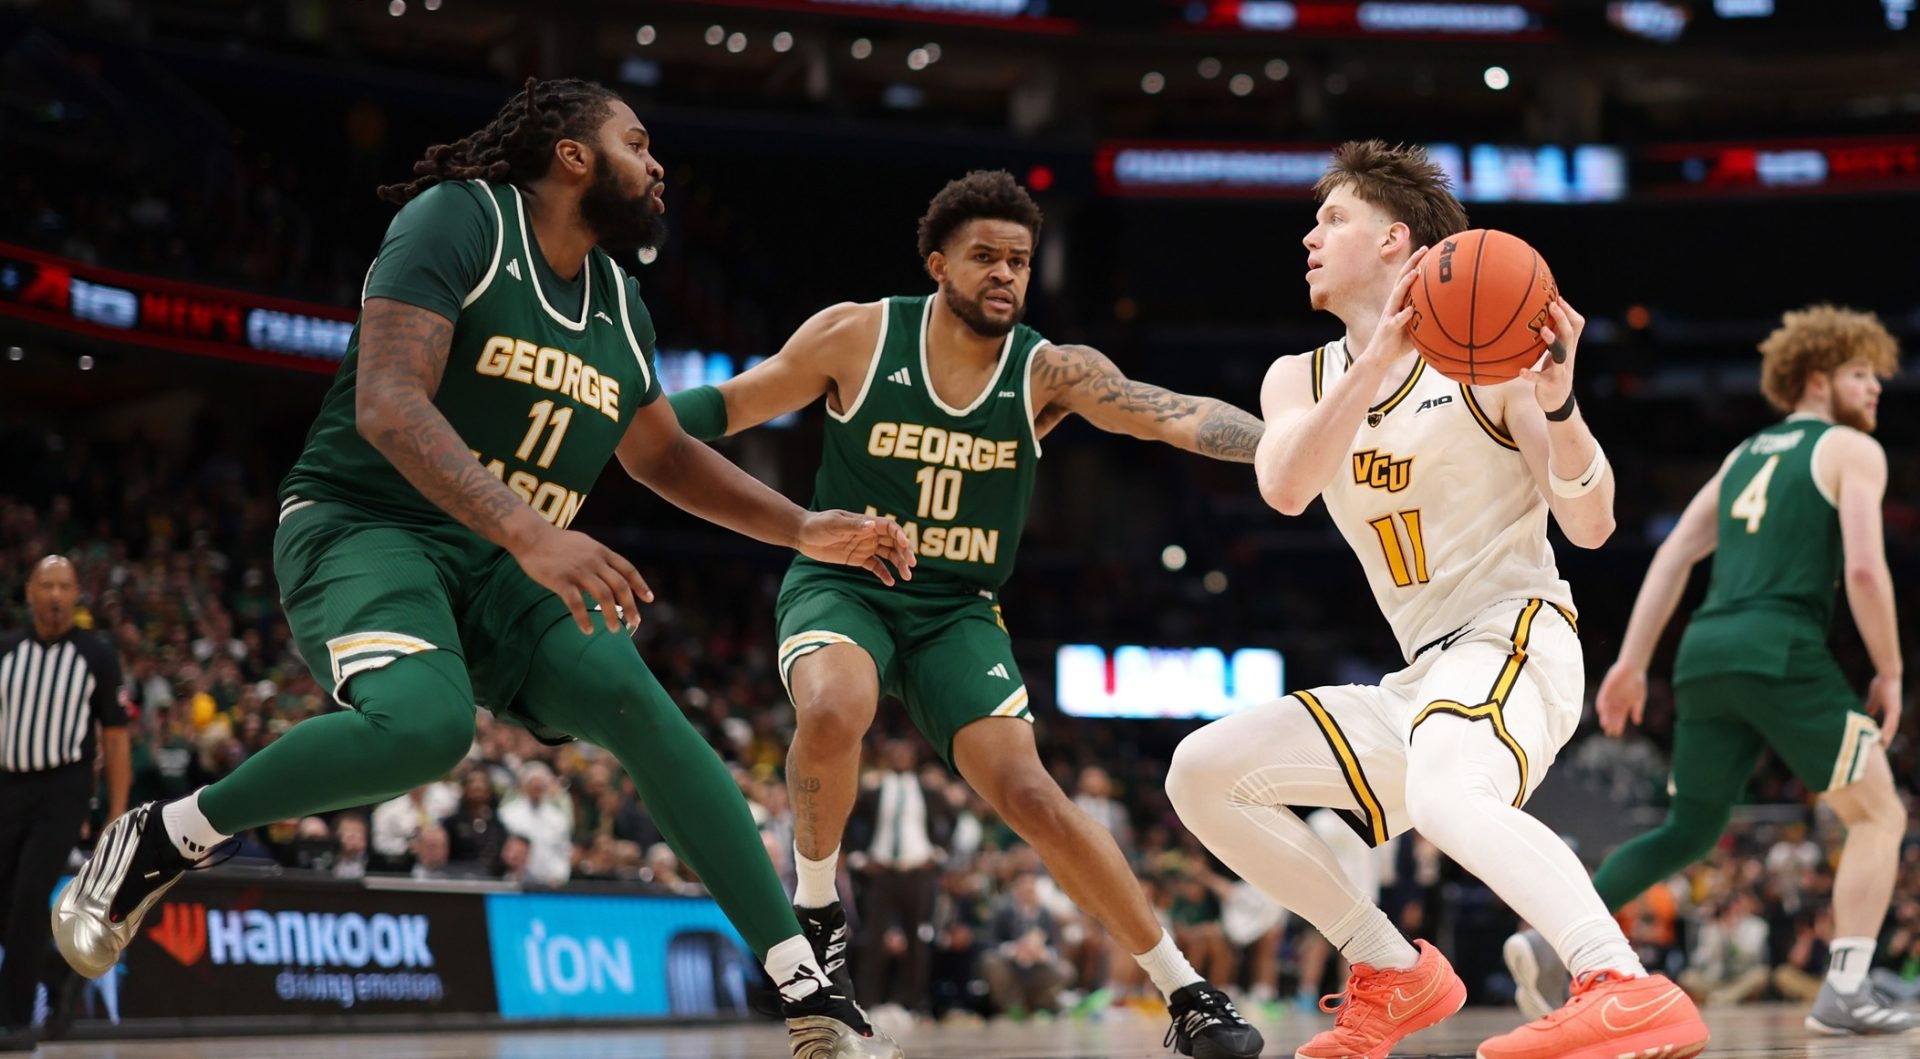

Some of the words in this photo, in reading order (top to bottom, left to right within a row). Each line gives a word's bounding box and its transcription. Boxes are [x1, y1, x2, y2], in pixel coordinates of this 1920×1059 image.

[1439, 240, 1458, 284] A10
[475, 335, 620, 423] GEORGE
[1416, 395, 1453, 414] A10
[514, 399, 575, 470] 11
[867, 421, 1018, 472] GEORGE
[470, 449, 587, 530] ASON
[916, 465, 963, 521] 10
[1352, 449, 1416, 493] VCU
[1730, 453, 1780, 534] 4
[864, 504, 999, 565] ASON
[1366, 509, 1430, 588] 11
[275, 966, 355, 1008] driving
[354, 967, 444, 1002] emotion
[524, 917, 635, 996] iON
